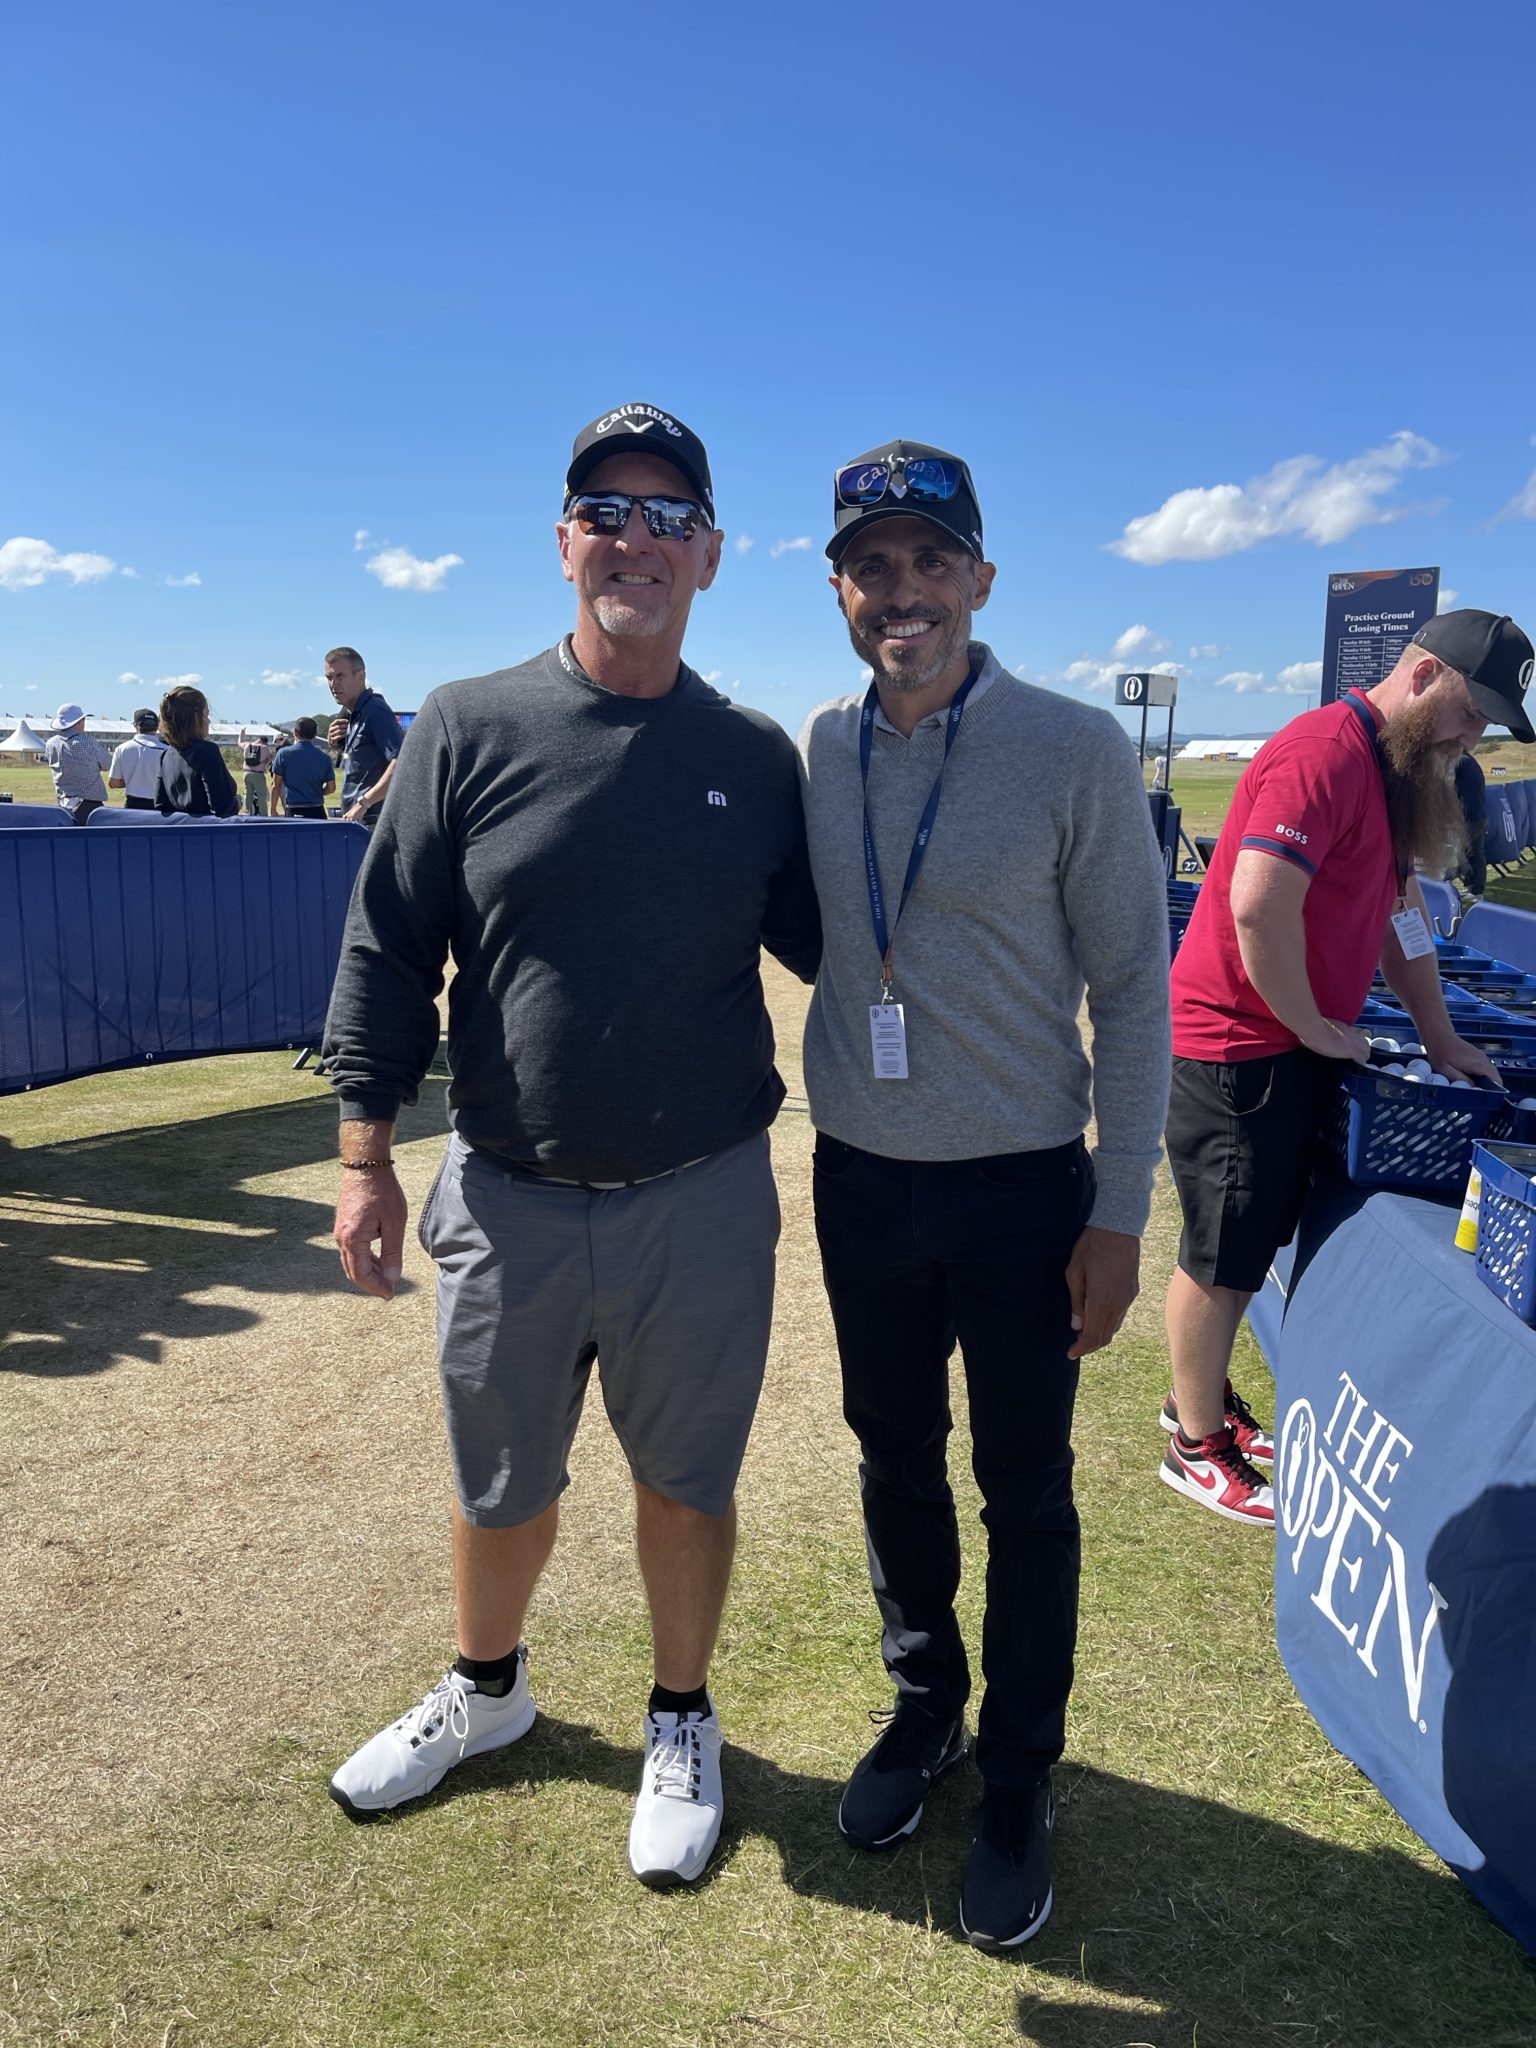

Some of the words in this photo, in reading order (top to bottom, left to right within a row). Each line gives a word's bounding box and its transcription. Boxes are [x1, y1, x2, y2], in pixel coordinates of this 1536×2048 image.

[597, 405, 682, 437] Callaway
[1344, 613, 1379, 622] Practice
[1380, 610, 1415, 620] Ground
[1348, 624, 1381, 634] Closing
[1382, 623, 1409, 632] Times
[1275, 824, 1308, 845] BOSS
[1184, 861, 1198, 872] 27
[1323, 1371, 1414, 1512] THE
[1279, 1398, 1449, 1723] OPEN
